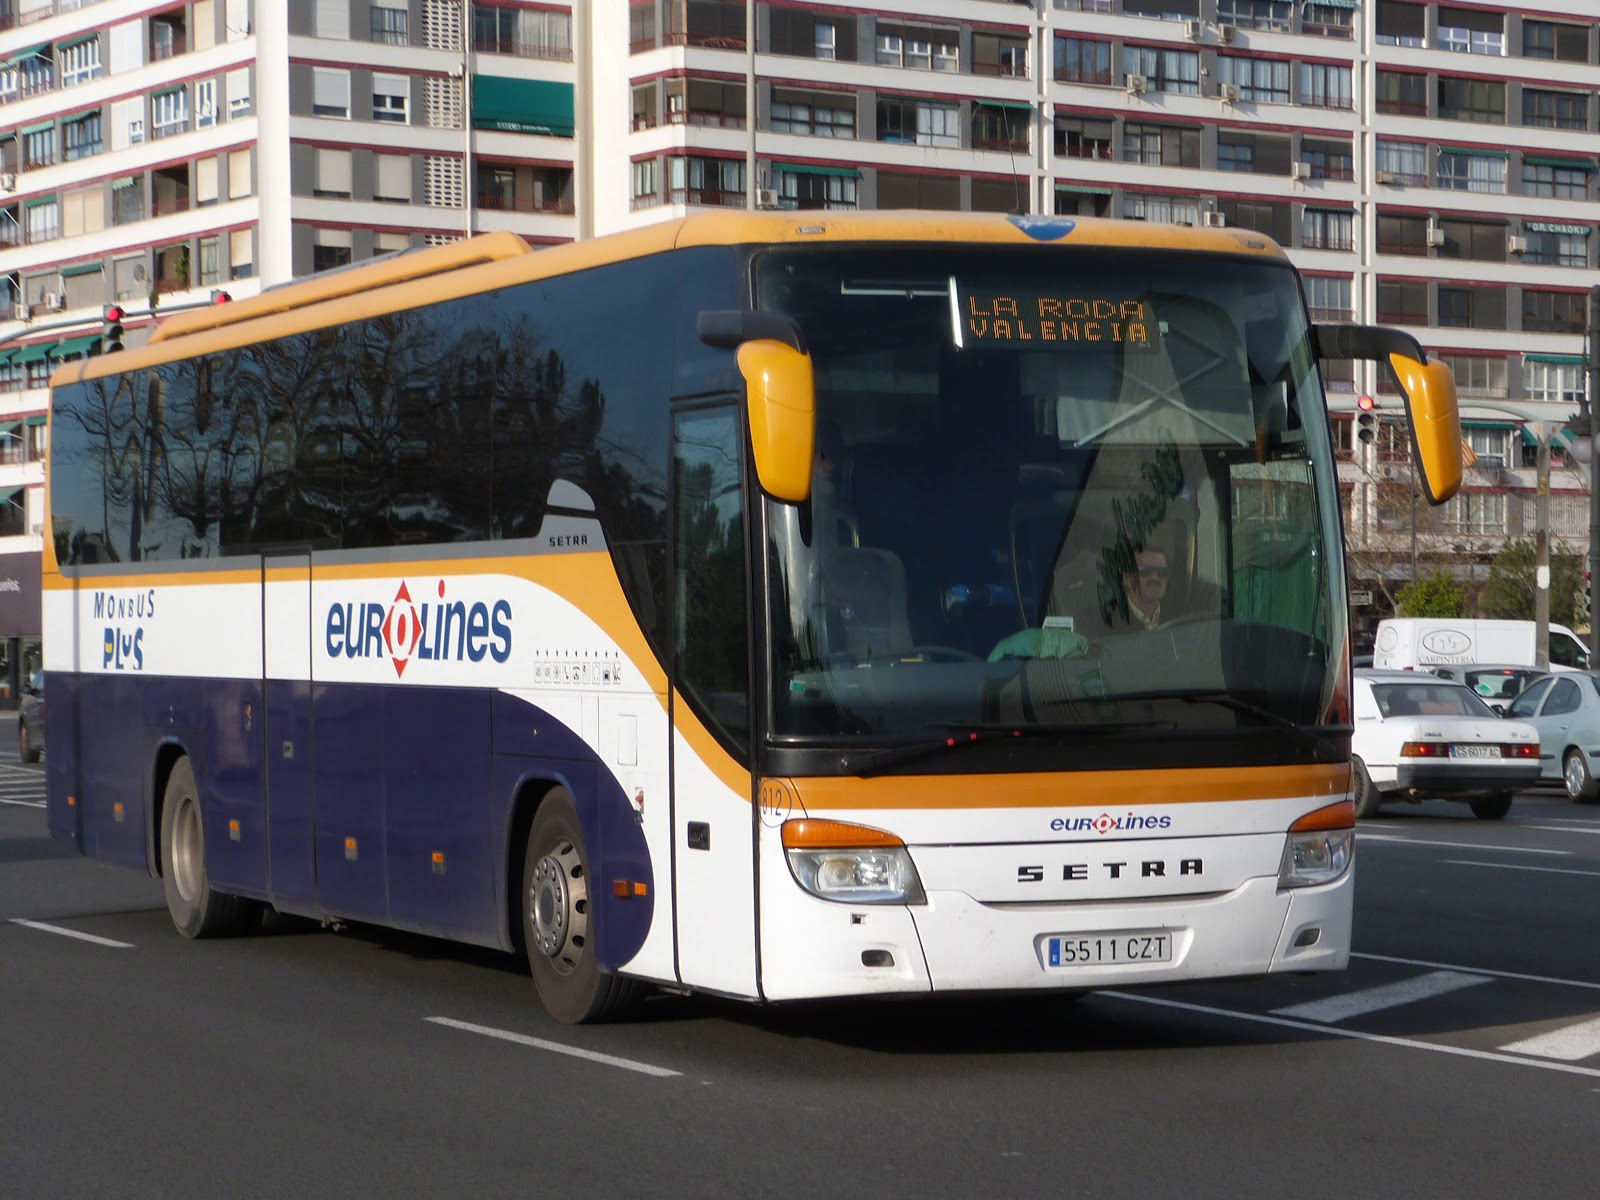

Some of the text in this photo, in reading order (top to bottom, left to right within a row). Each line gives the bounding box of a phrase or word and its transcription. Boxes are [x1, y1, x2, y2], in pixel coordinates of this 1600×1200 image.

[970, 296, 1143, 320] LA RODA
[970, 319, 1146, 342] VALENCIA
[549, 535, 588, 547] SETRA
[94, 589, 155, 619] MONBUS
[1469, 746, 1488, 757] 6017
[762, 787, 782, 816] 812
[1018, 858, 1203, 882] SETRA
[1065, 940, 1116, 962] 5511
[1127, 937, 1166, 959] CZT
